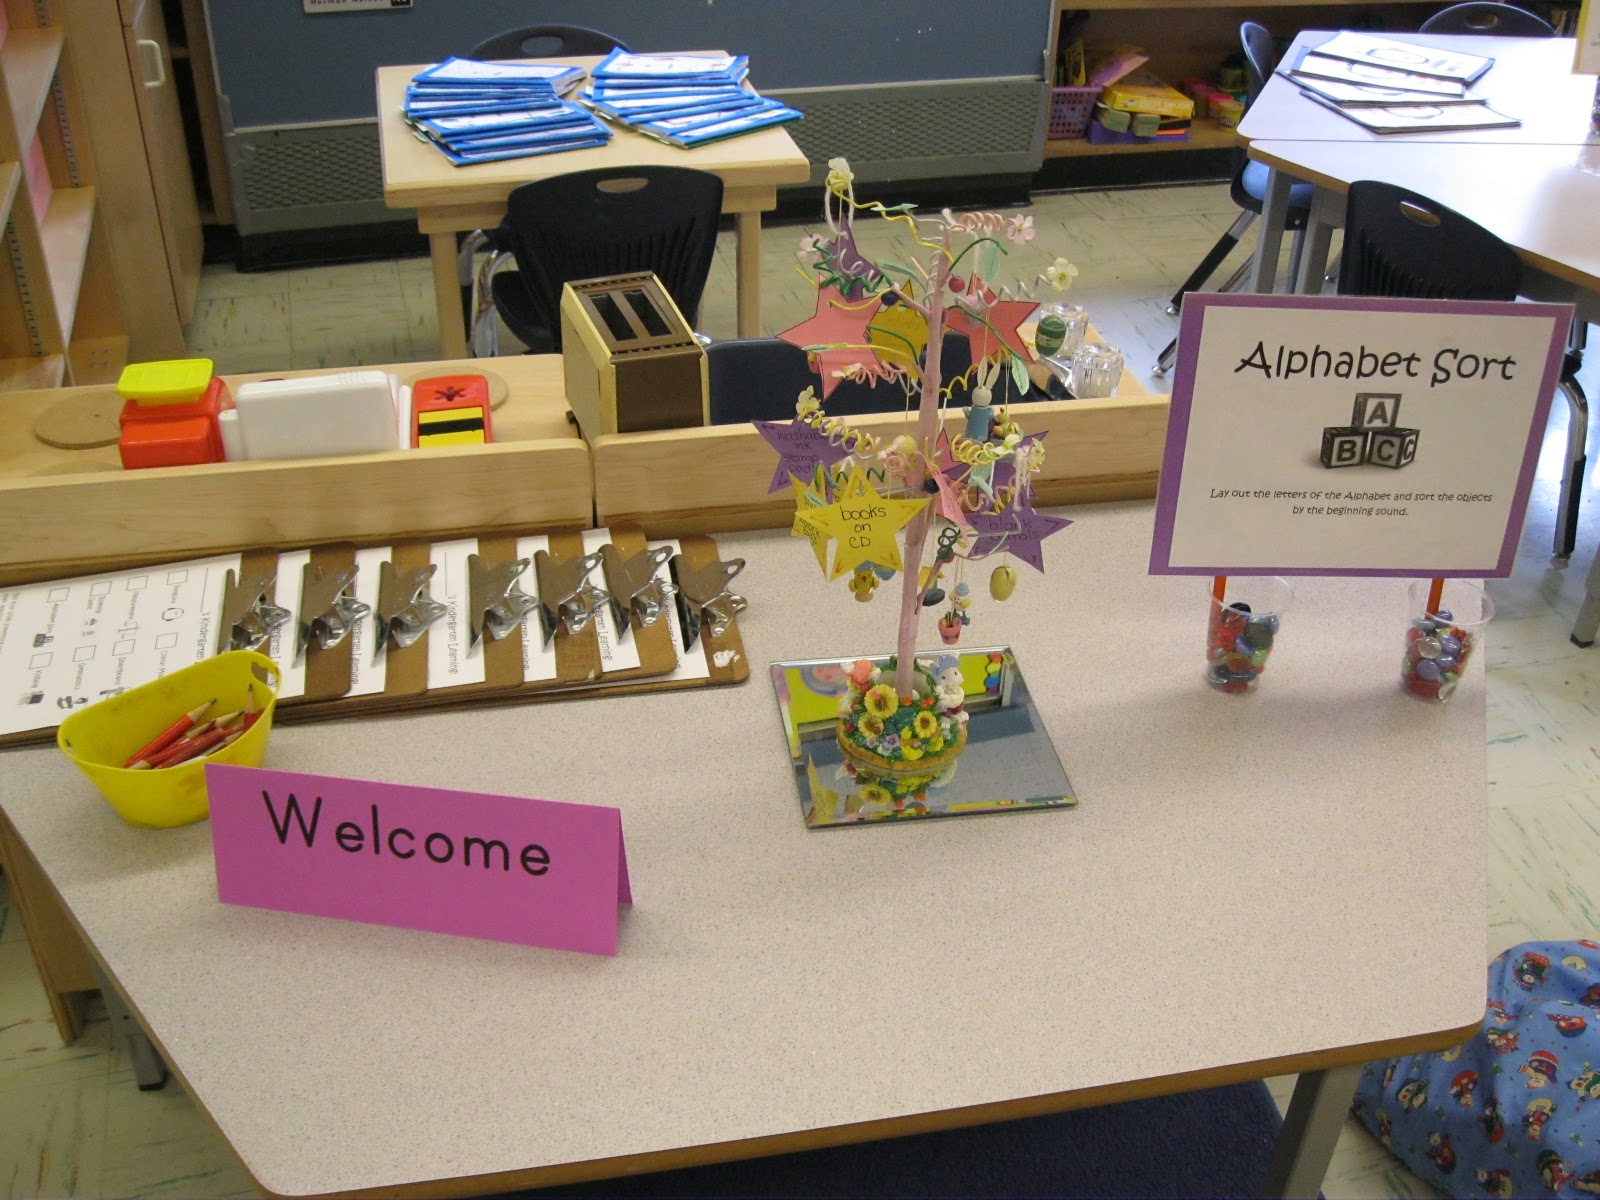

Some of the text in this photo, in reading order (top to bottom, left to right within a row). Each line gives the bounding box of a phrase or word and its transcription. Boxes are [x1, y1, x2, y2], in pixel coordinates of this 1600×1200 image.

[1234, 341, 1517, 387] Alphabet Sort
[1367, 401, 1388, 424] A
[1336, 439, 1357, 462] B
[1377, 439, 1395, 462] C
[788, 463, 816, 474] pad
[1210, 488, 1493, 503] Lay out the letters of the Alphabet and sort the objects
[840, 504, 887, 521] books
[1292, 505, 1408, 517] by the beginning sound.
[854, 522, 872, 533] on
[848, 536, 871, 548] CD
[446, 601, 458, 643] Kindergarten
[196, 617, 211, 660] Kindergarten
[598, 631, 613, 661] Learning!
[447, 643, 459, 674] Learning!
[262, 789, 551, 877] Welcome
